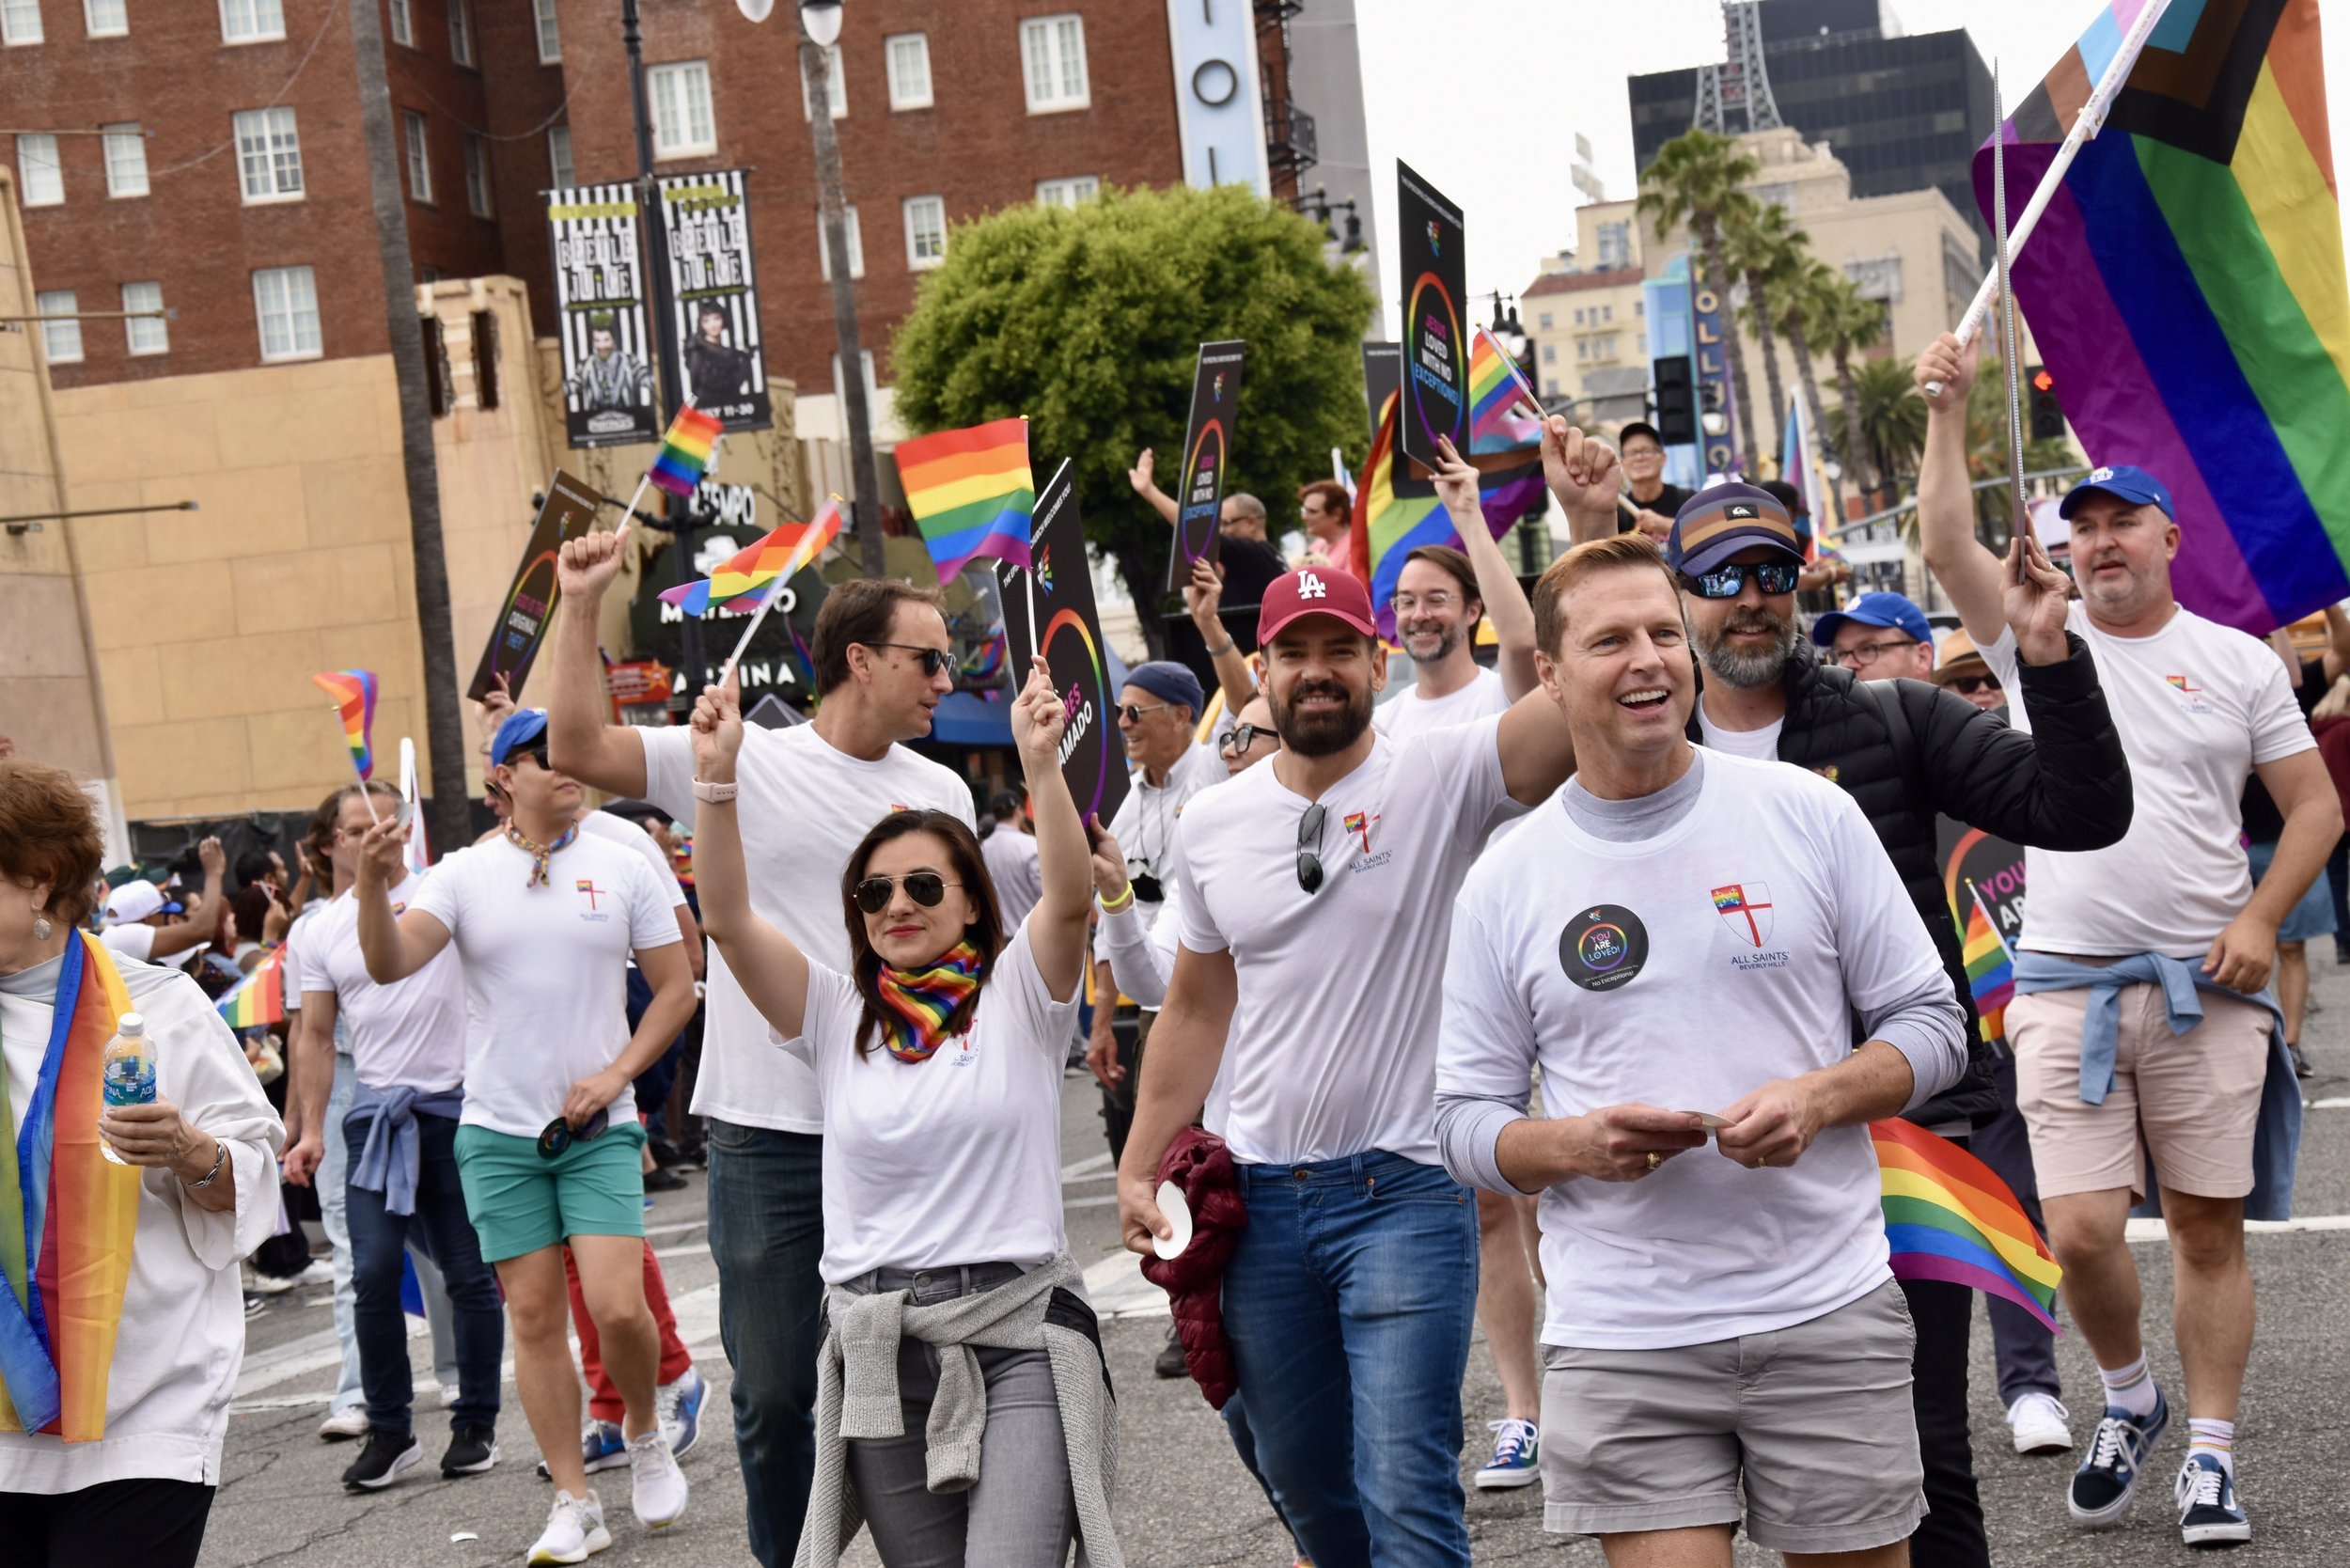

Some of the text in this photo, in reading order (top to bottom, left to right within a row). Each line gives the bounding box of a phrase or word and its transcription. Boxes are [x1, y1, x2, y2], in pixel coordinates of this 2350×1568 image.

[671, 220, 743, 258] BEETLE
[559, 232, 634, 269] BEETLE
[1424, 331, 1449, 360] LOVED
[1421, 347, 1452, 382] WITH NO
[1297, 570, 1325, 600] LA
[1058, 700, 1092, 768] AMADO
[1348, 860, 1363, 870] ALL
[1355, 859, 1390, 873] BEVERLY HILLS
[1590, 931, 1611, 943] YOU
[1594, 940, 1611, 951] ARE
[1588, 946, 1621, 962] LOVED!
[1731, 955, 1750, 965] ALL
[1739, 961, 1786, 971] BEVERLY HILLS
[1601, 970, 1635, 985] Exceptions!
